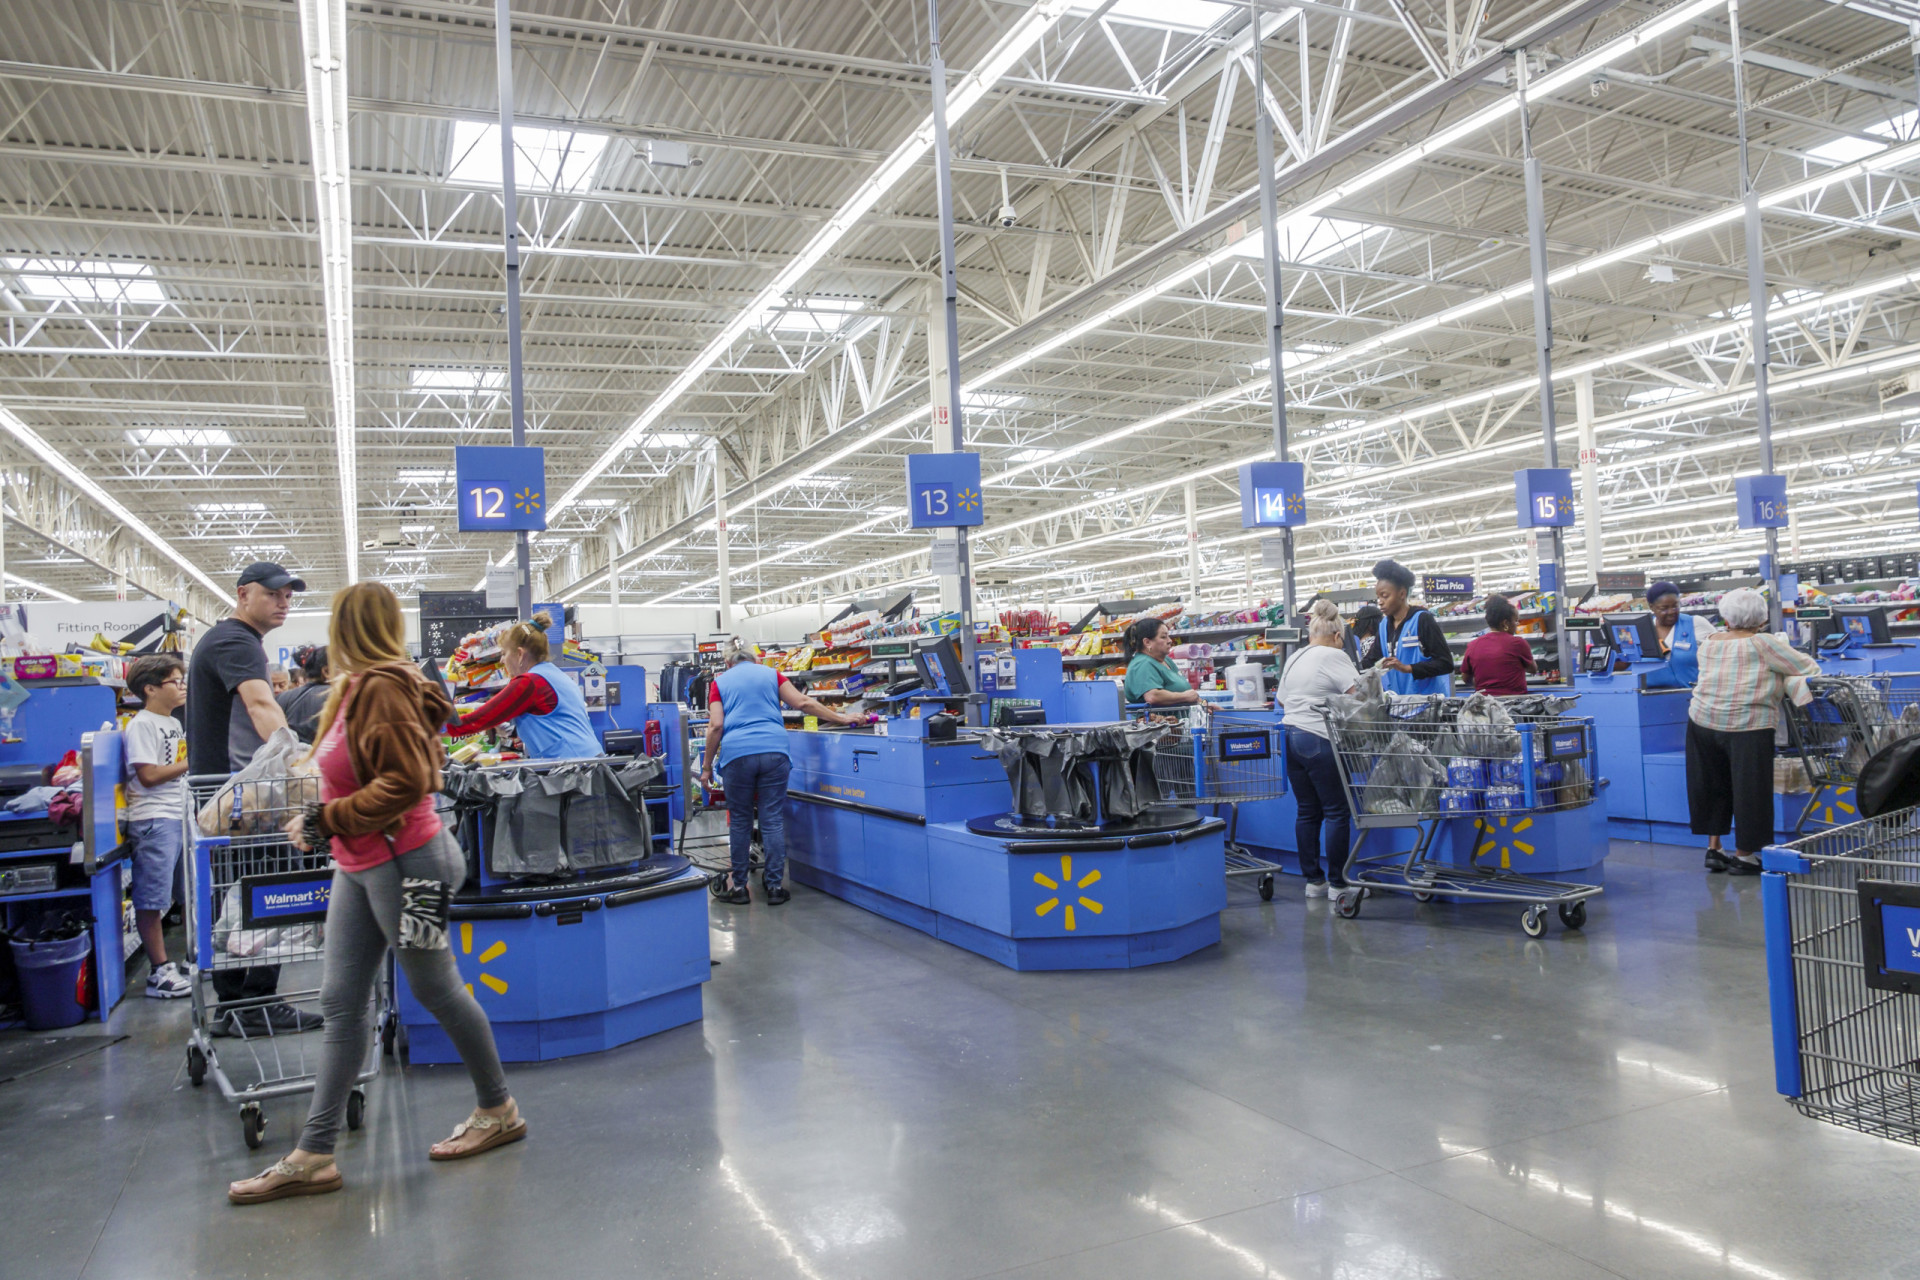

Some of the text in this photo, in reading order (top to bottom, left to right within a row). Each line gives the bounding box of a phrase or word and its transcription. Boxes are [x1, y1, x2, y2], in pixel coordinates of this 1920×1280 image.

[470, 487, 506, 518] 12
[921, 489, 949, 516] 13
[1262, 493, 1285, 517] 14
[1536, 496, 1556, 518] 15
[1759, 501, 1774, 520] 16
[1436, 581, 1464, 590] Low Price
[57, 621, 140, 633] Fitting Room
[1230, 742, 1253, 750] Walmart
[264, 890, 314, 905] Walmart
